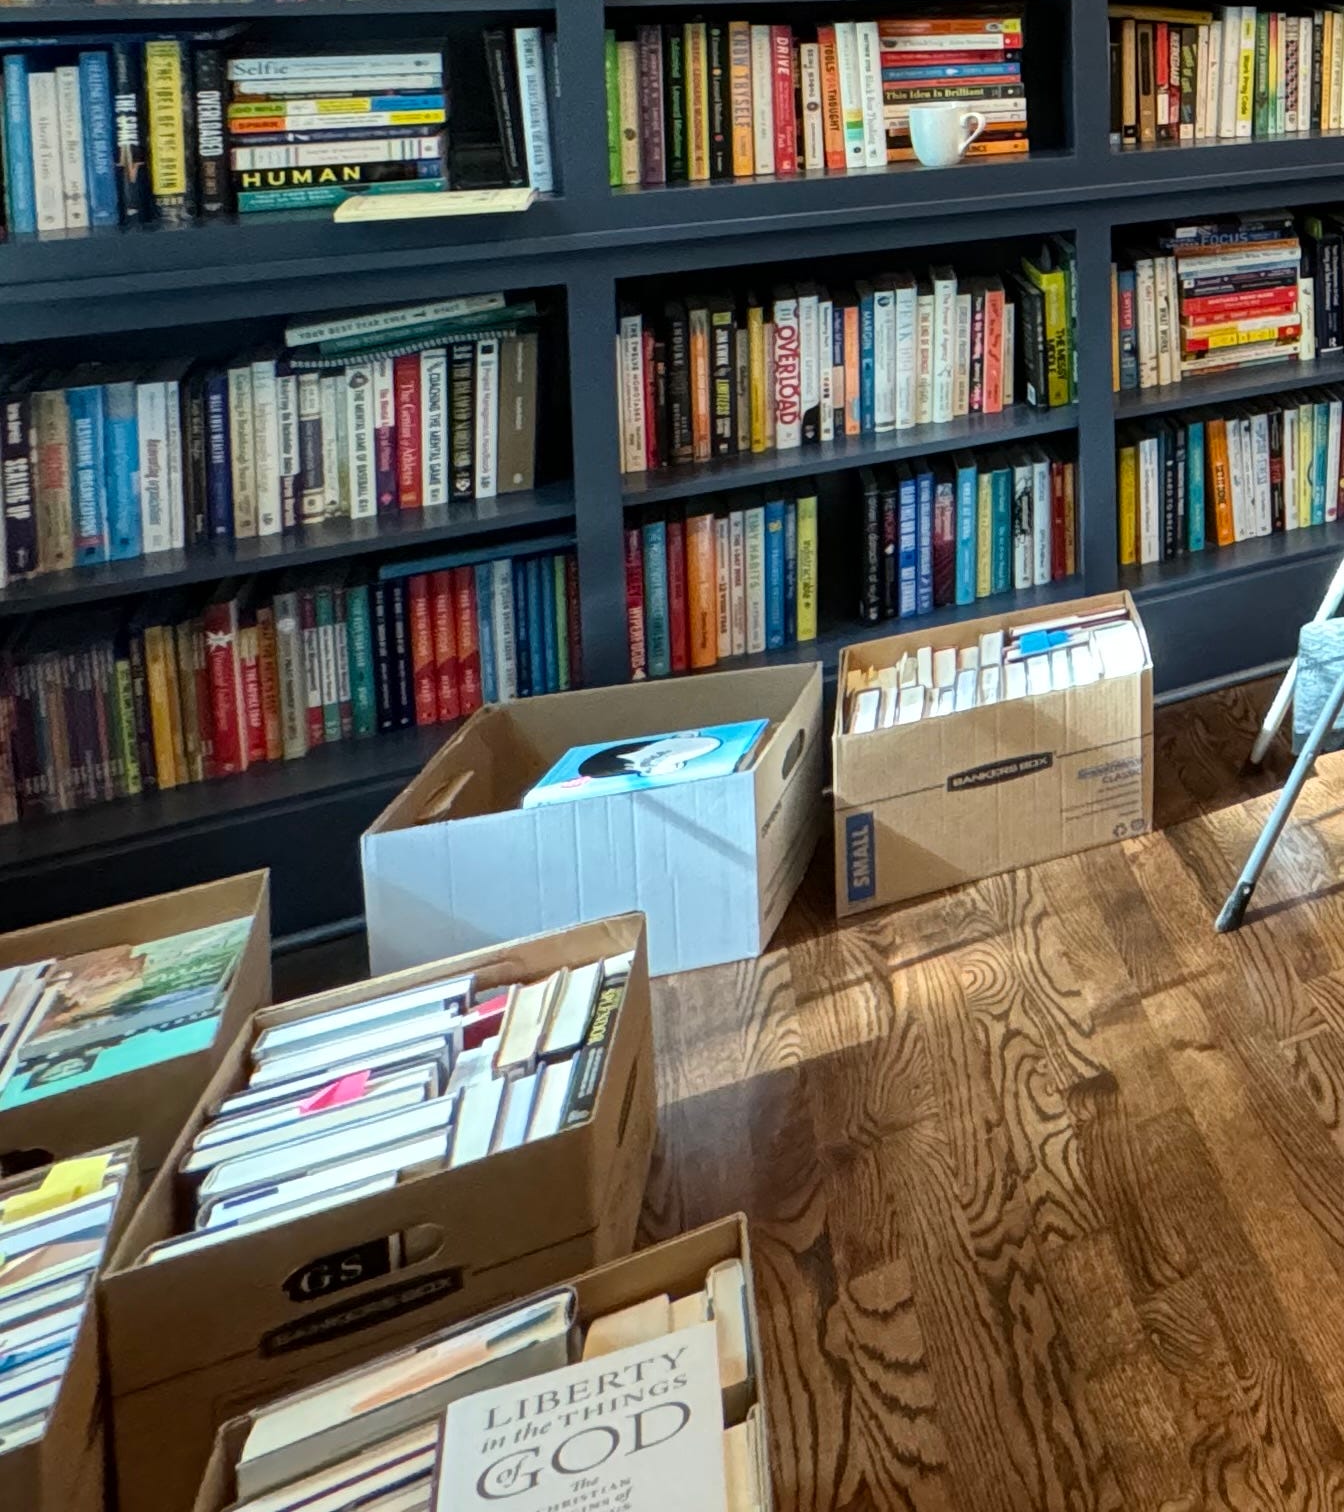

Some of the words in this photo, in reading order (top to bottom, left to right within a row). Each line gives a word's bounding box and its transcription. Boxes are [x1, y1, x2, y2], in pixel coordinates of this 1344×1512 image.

[731, 29, 751, 66] KNOW
[776, 37, 791, 75] DRIVE
[231, 61, 290, 77] Selfie
[115, 93, 137, 113] THE
[733, 67, 751, 128] THYSELF
[196, 90, 224, 157] OVERLOADED
[242, 165, 361, 188] HUMAN
[1200, 231, 1250, 245] FOCUS
[861, 310, 874, 350] MARGIN
[778, 323, 801, 426] OVERLOAD
[1046, 338, 1058, 373] MIDDLE
[1055, 348, 1068, 380] MESSY
[951, 764, 1020, 788] BANKERS
[1019, 757, 1050, 773] BOX
[851, 824, 870, 889] SMALL
[482, 1345, 690, 1433] LIBERTY
[481, 1433, 510, 1457] in
[513, 1417, 554, 1448] the
[555, 1372, 690, 1431] THINGS
[476, 1399, 692, 1502] GOD
